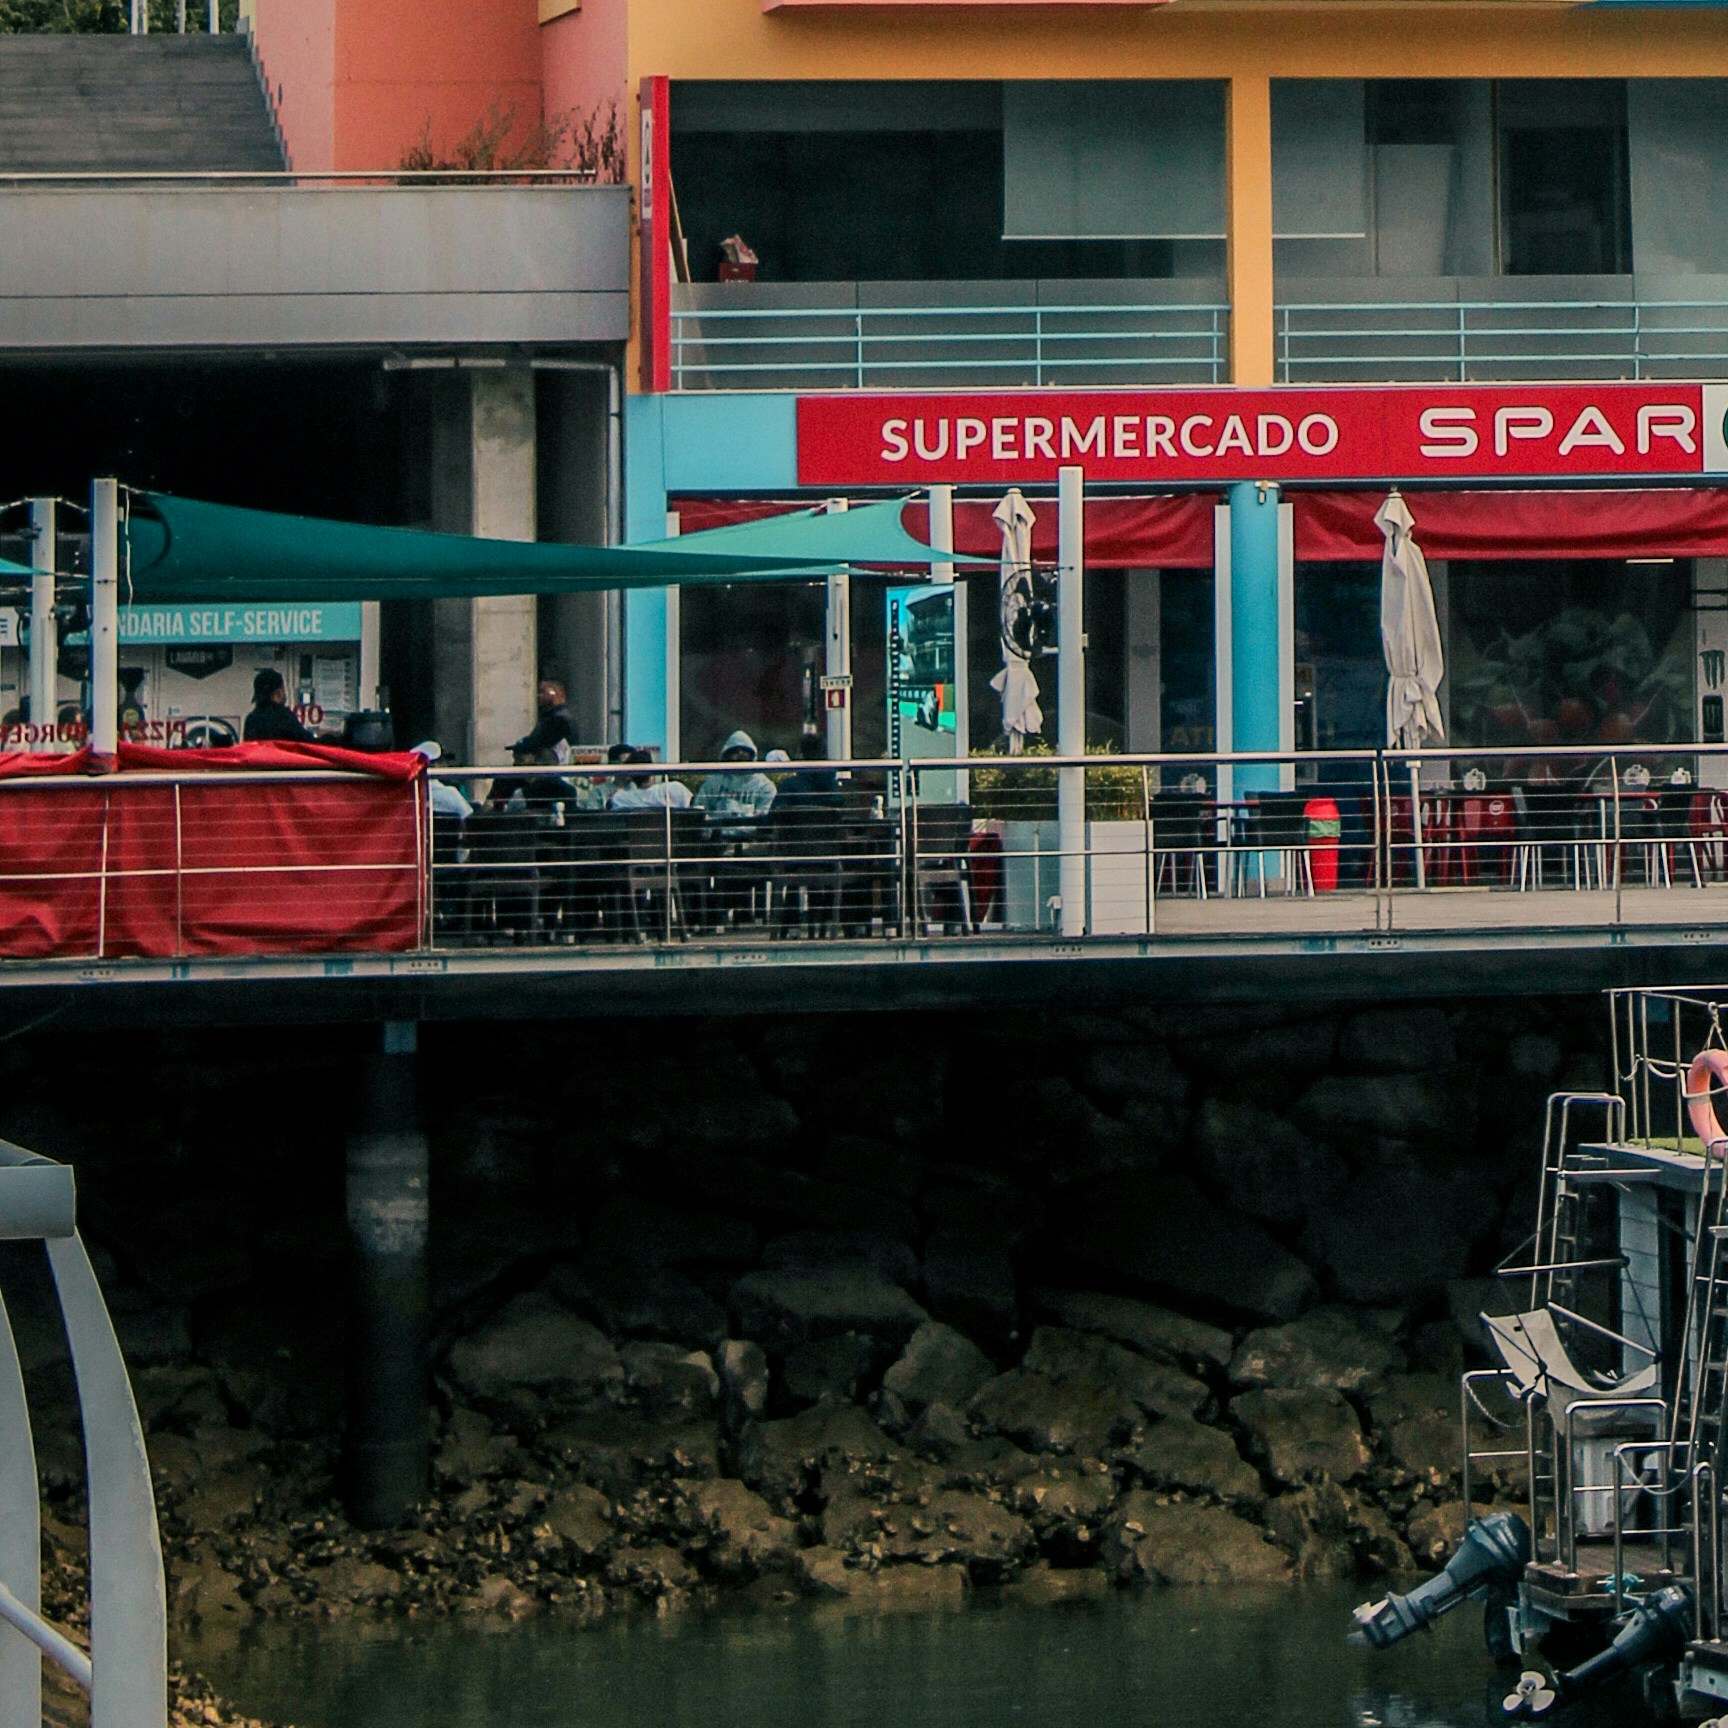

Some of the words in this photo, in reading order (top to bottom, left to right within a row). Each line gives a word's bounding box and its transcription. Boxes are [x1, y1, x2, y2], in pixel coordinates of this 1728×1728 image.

[880, 413, 1339, 462] SUPERMERCADO
[1419, 404, 1696, 457] SPAR
[117, 611, 185, 638] NDARIA
[189, 609, 323, 636] SELF-SERVICE
